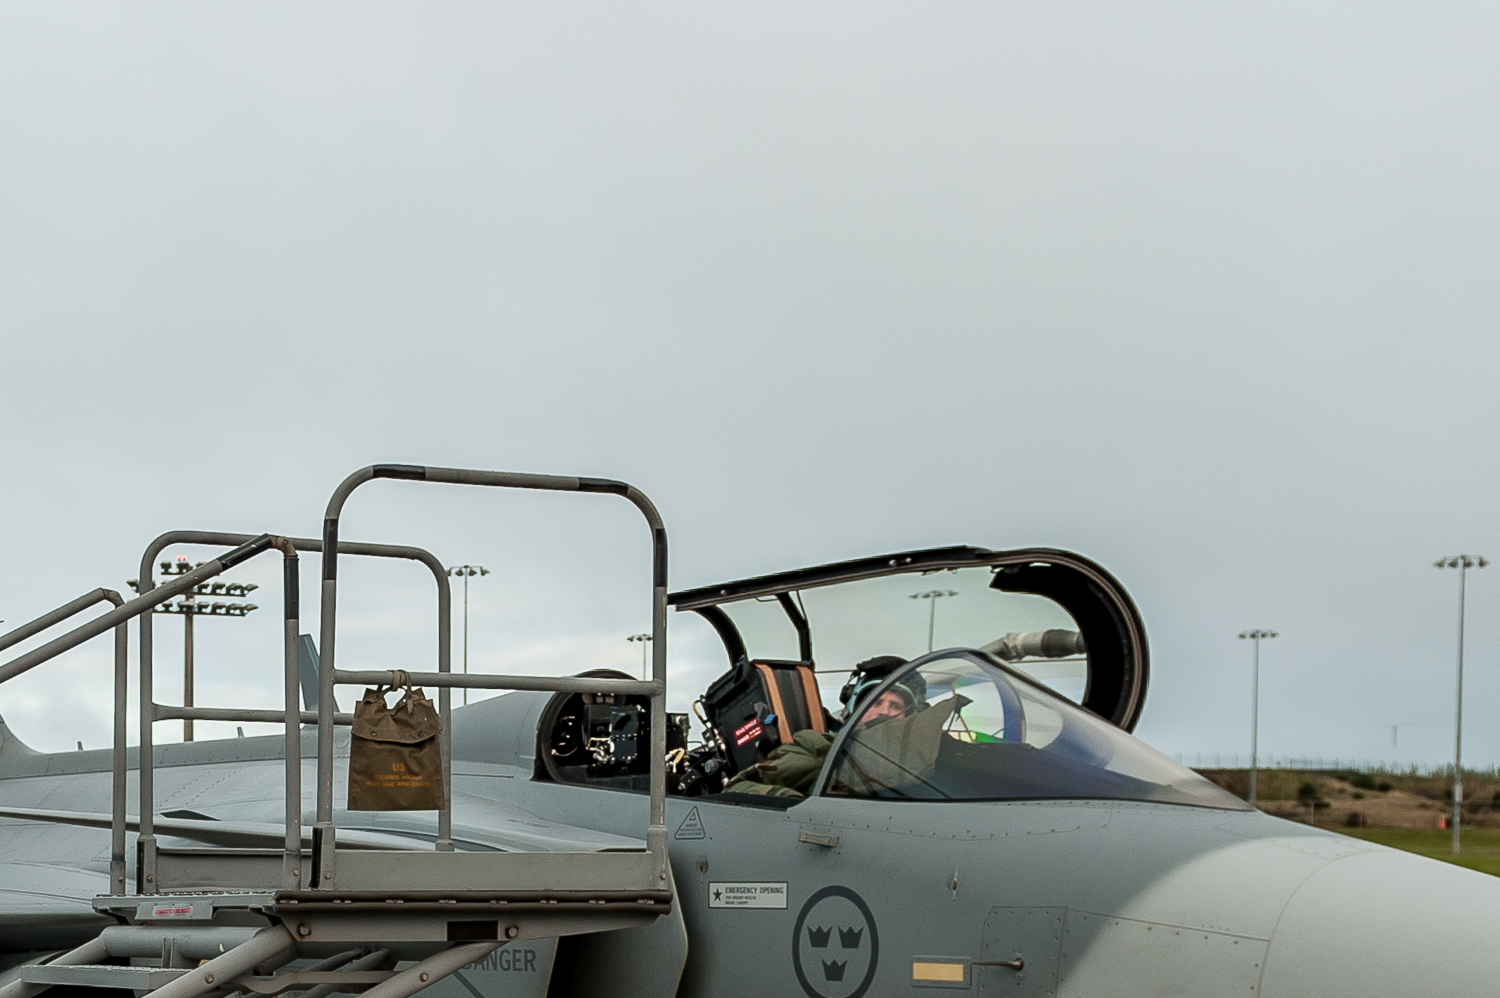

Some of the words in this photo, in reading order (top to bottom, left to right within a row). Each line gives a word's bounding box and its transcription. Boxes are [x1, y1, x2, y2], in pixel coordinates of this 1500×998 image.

[392, 763, 406, 772] US
[725, 886, 757, 895] EMERGENCY
[759, 886, 784, 895] OPENING
